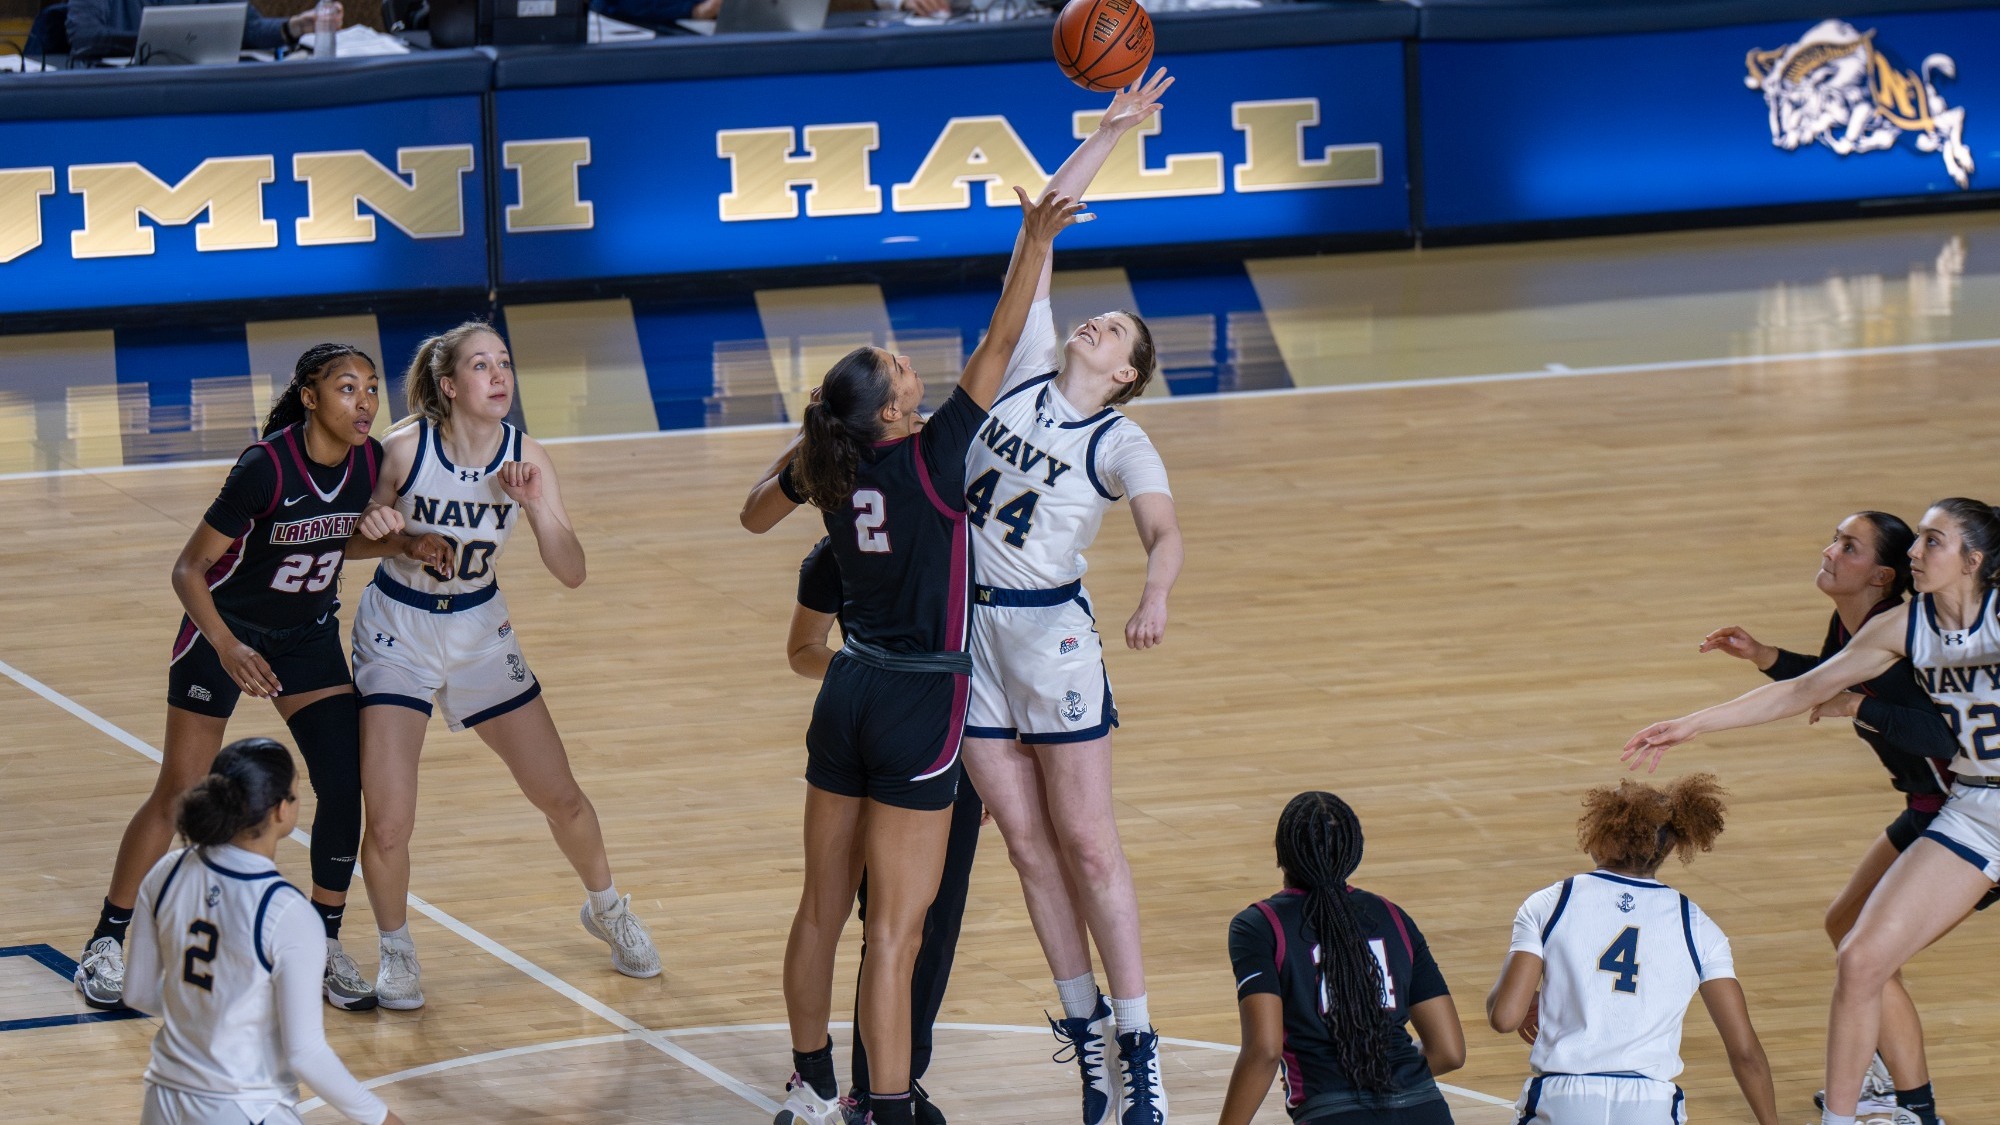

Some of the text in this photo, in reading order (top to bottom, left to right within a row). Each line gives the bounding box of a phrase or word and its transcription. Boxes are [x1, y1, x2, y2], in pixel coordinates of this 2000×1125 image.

[1092, 12, 1120, 43] THE
[717, 97, 1383, 222] HALL
[979, 415, 1072, 488] NAVY
[412, 494, 512, 530] NAVY
[852, 488, 892, 554] 2
[966, 466, 1041, 551] 44
[269, 550, 343, 593] 23
[436, 599, 449, 610] N
[979, 589, 991, 602] N
[182, 917, 219, 991] 2
[1597, 925, 1641, 995] 4
